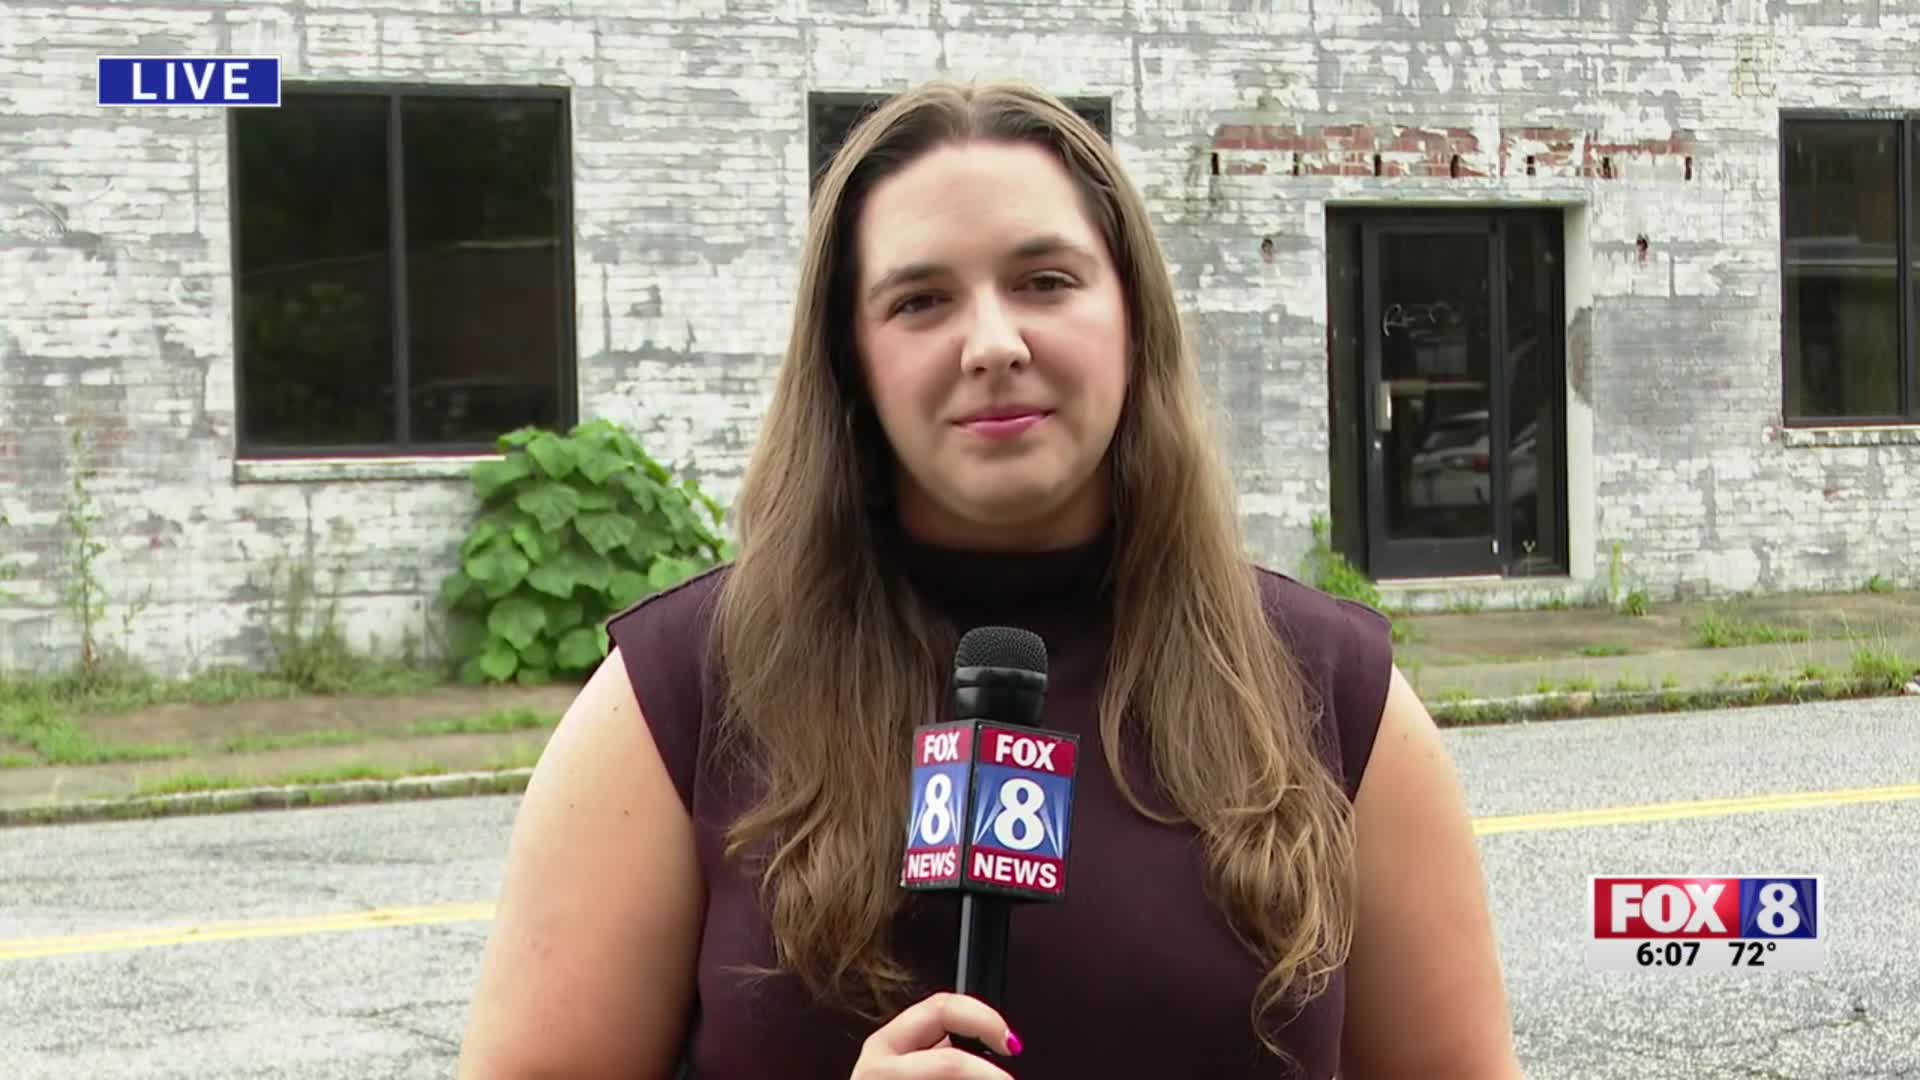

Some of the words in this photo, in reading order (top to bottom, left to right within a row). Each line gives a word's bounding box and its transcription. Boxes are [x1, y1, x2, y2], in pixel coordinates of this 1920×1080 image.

[923, 732, 961, 763] FOX
[995, 733, 1056, 771] FOX
[921, 773, 952, 845] 8
[993, 778, 1045, 851] 8
[907, 851, 956, 879] NEWS
[973, 852, 1057, 888] NEWS
